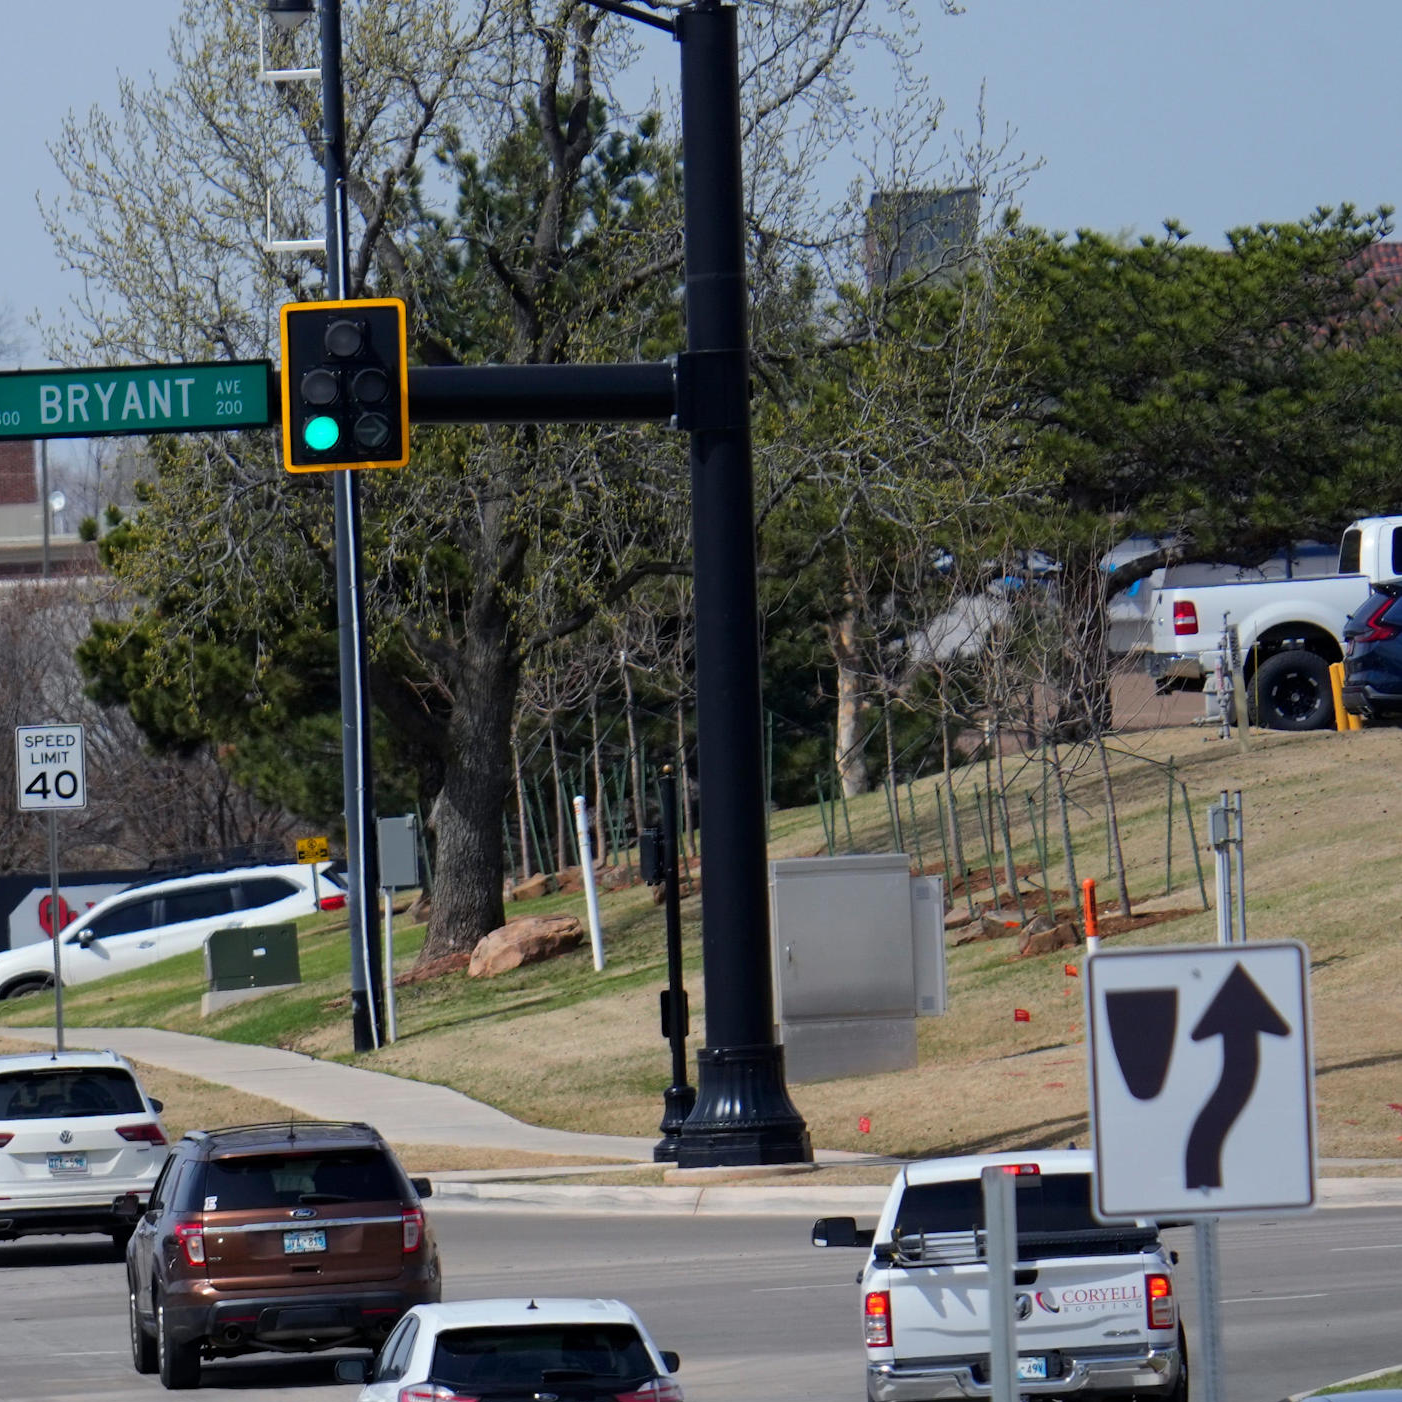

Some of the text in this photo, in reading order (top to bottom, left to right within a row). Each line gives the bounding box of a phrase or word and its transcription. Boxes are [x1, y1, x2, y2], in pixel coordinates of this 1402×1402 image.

[215, 380, 242, 395] AVE
[39, 378, 195, 425] BRYANT
[215, 400, 243, 415] 200
[24, 734, 76, 748] SPEED
[30, 751, 70, 765] LIMIT
[24, 770, 78, 800] 40
[1062, 1286, 1142, 1304] CORYELL
[1063, 1301, 1143, 1313] ROOFING
